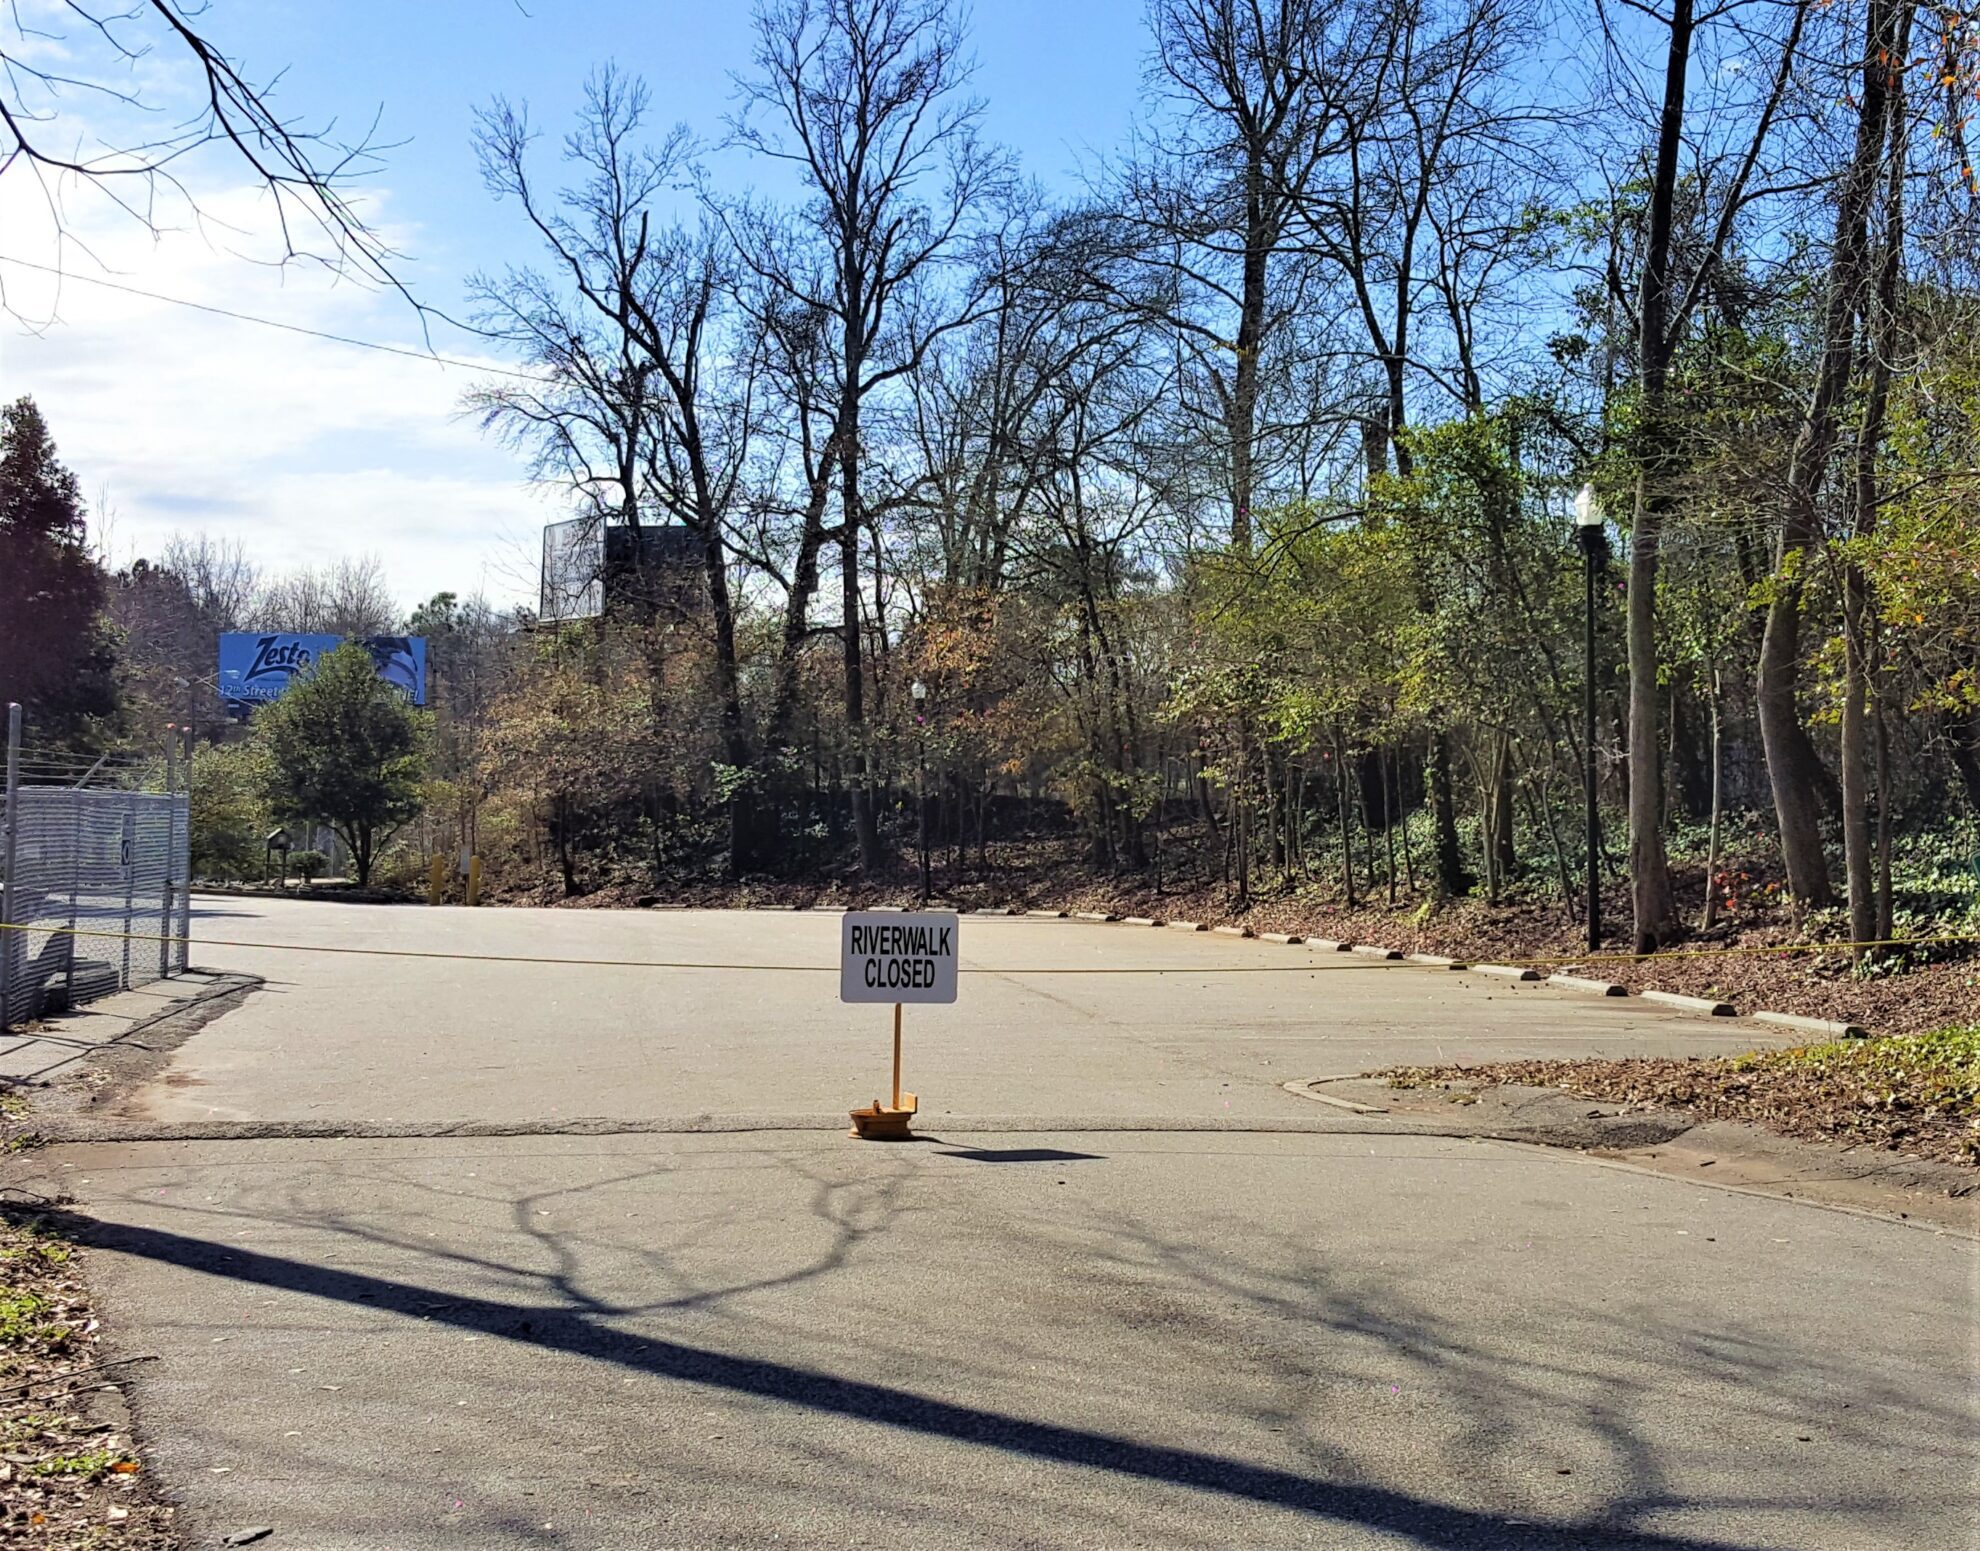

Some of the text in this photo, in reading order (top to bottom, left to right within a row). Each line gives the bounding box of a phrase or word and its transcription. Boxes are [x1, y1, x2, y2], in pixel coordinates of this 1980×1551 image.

[243, 635, 311, 682] Zesto
[219, 685, 241, 696] 12th
[243, 684, 278, 697] Street
[851, 925, 951, 956] RIVERWALK
[865, 958, 935, 988] CLOSED
